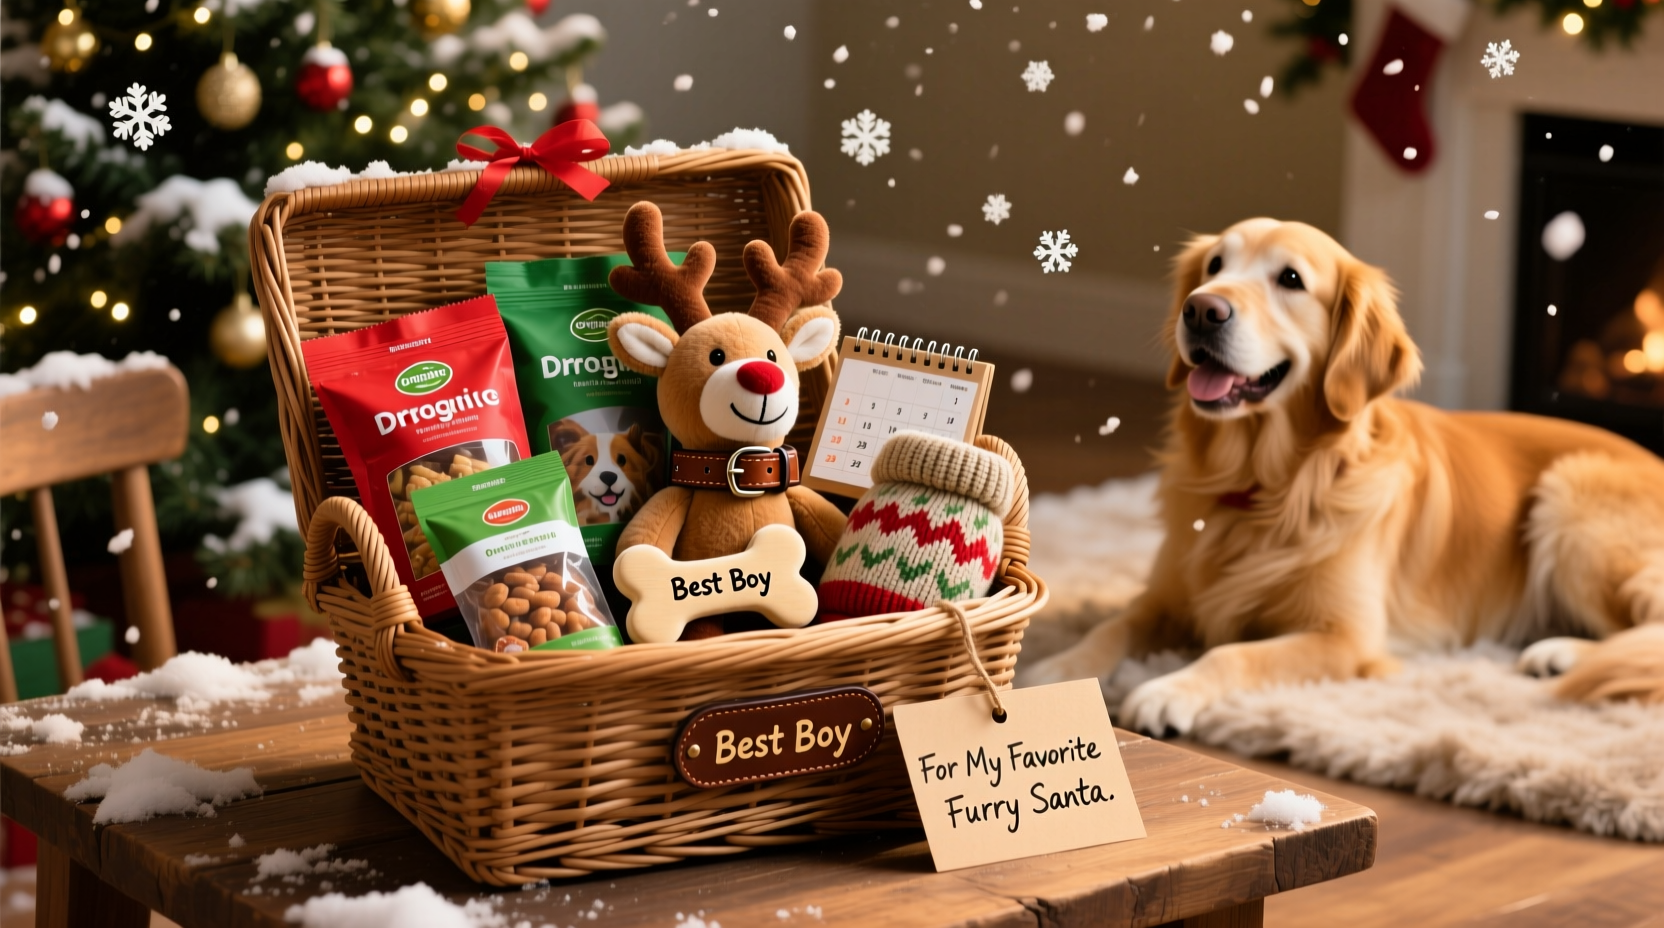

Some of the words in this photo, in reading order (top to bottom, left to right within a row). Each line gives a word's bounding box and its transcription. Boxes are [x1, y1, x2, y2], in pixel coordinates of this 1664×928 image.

[670, 572, 723, 601] Best
[729, 568, 771, 597] Boy
[715, 724, 785, 765] Best
[795, 719, 852, 758] Boy
[918, 752, 958, 783] For
[966, 746, 1001, 787] My
[1007, 736, 1101, 771] Favorite
[944, 794, 1020, 833] Furry
[1030, 777, 1115, 814] Santa.
